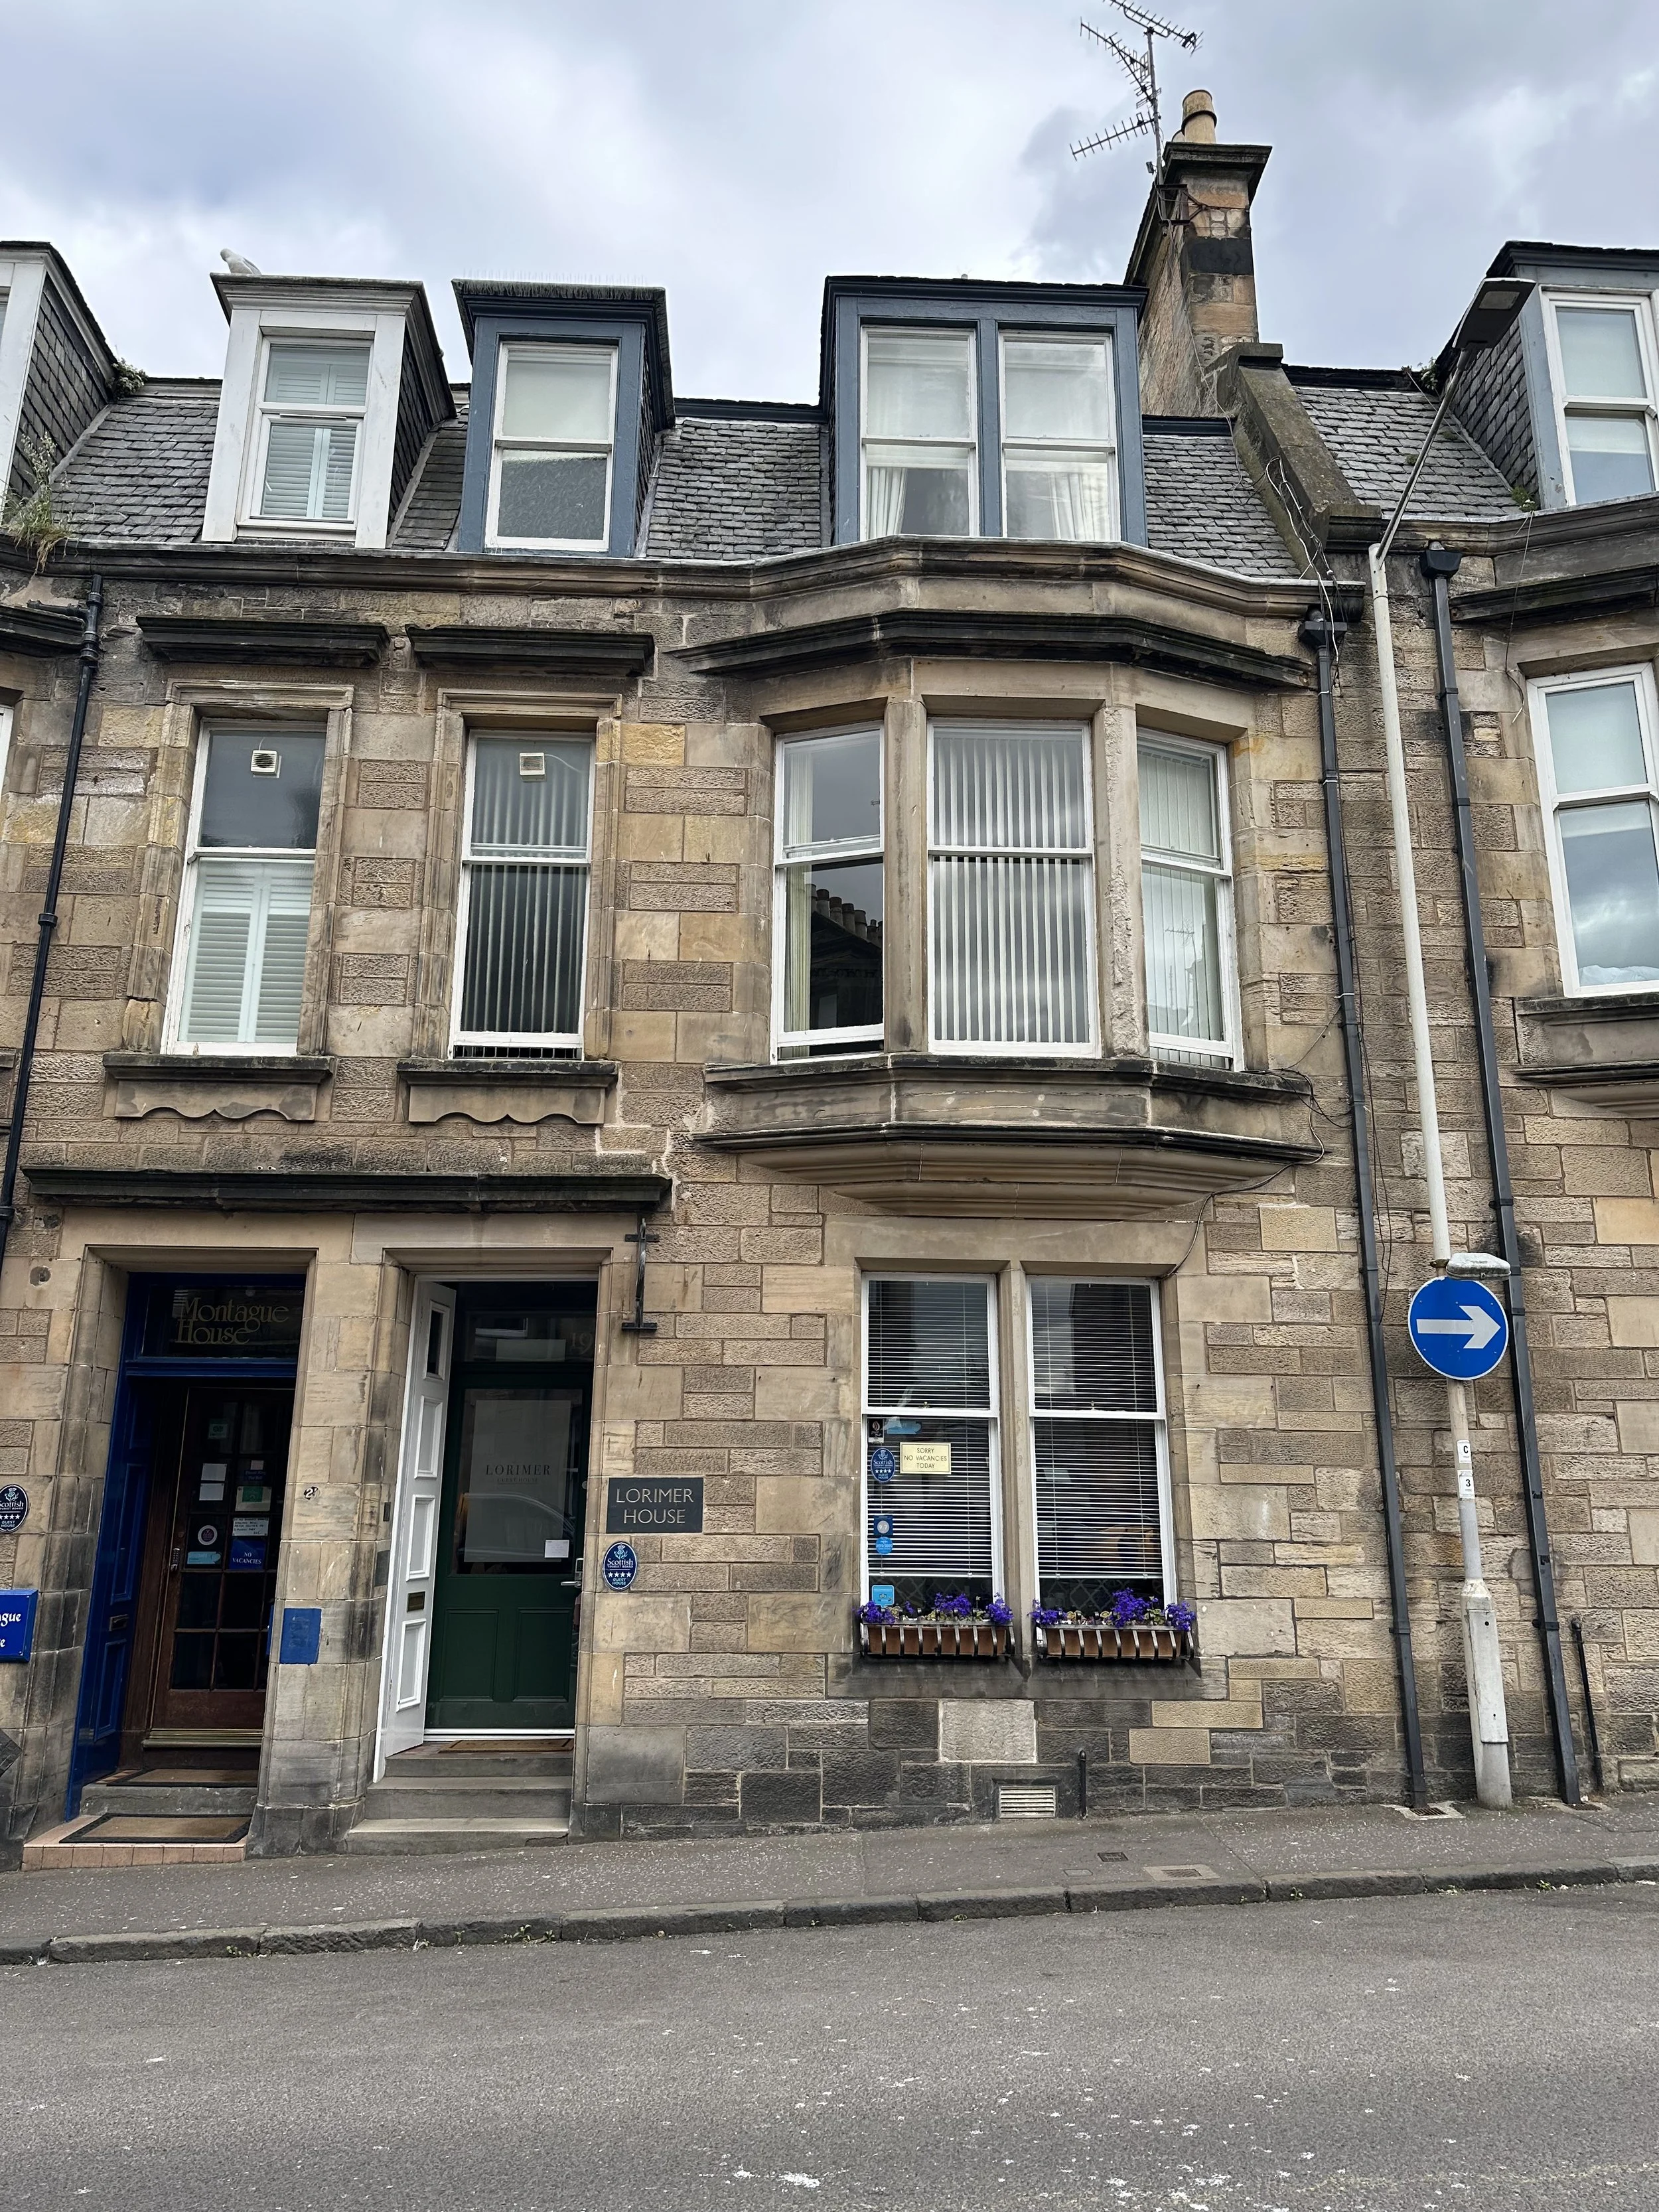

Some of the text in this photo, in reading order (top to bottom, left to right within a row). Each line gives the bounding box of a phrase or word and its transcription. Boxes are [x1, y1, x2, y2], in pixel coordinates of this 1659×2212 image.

[177, 1297, 289, 1332] Montague
[175, 1319, 250, 1345] House
[570, 1332, 593, 1355] 19
[486, 1465, 551, 1475] LORIMER
[616, 1488, 694, 1503] LORIMER
[623, 1509, 686, 1524] HOUSE
